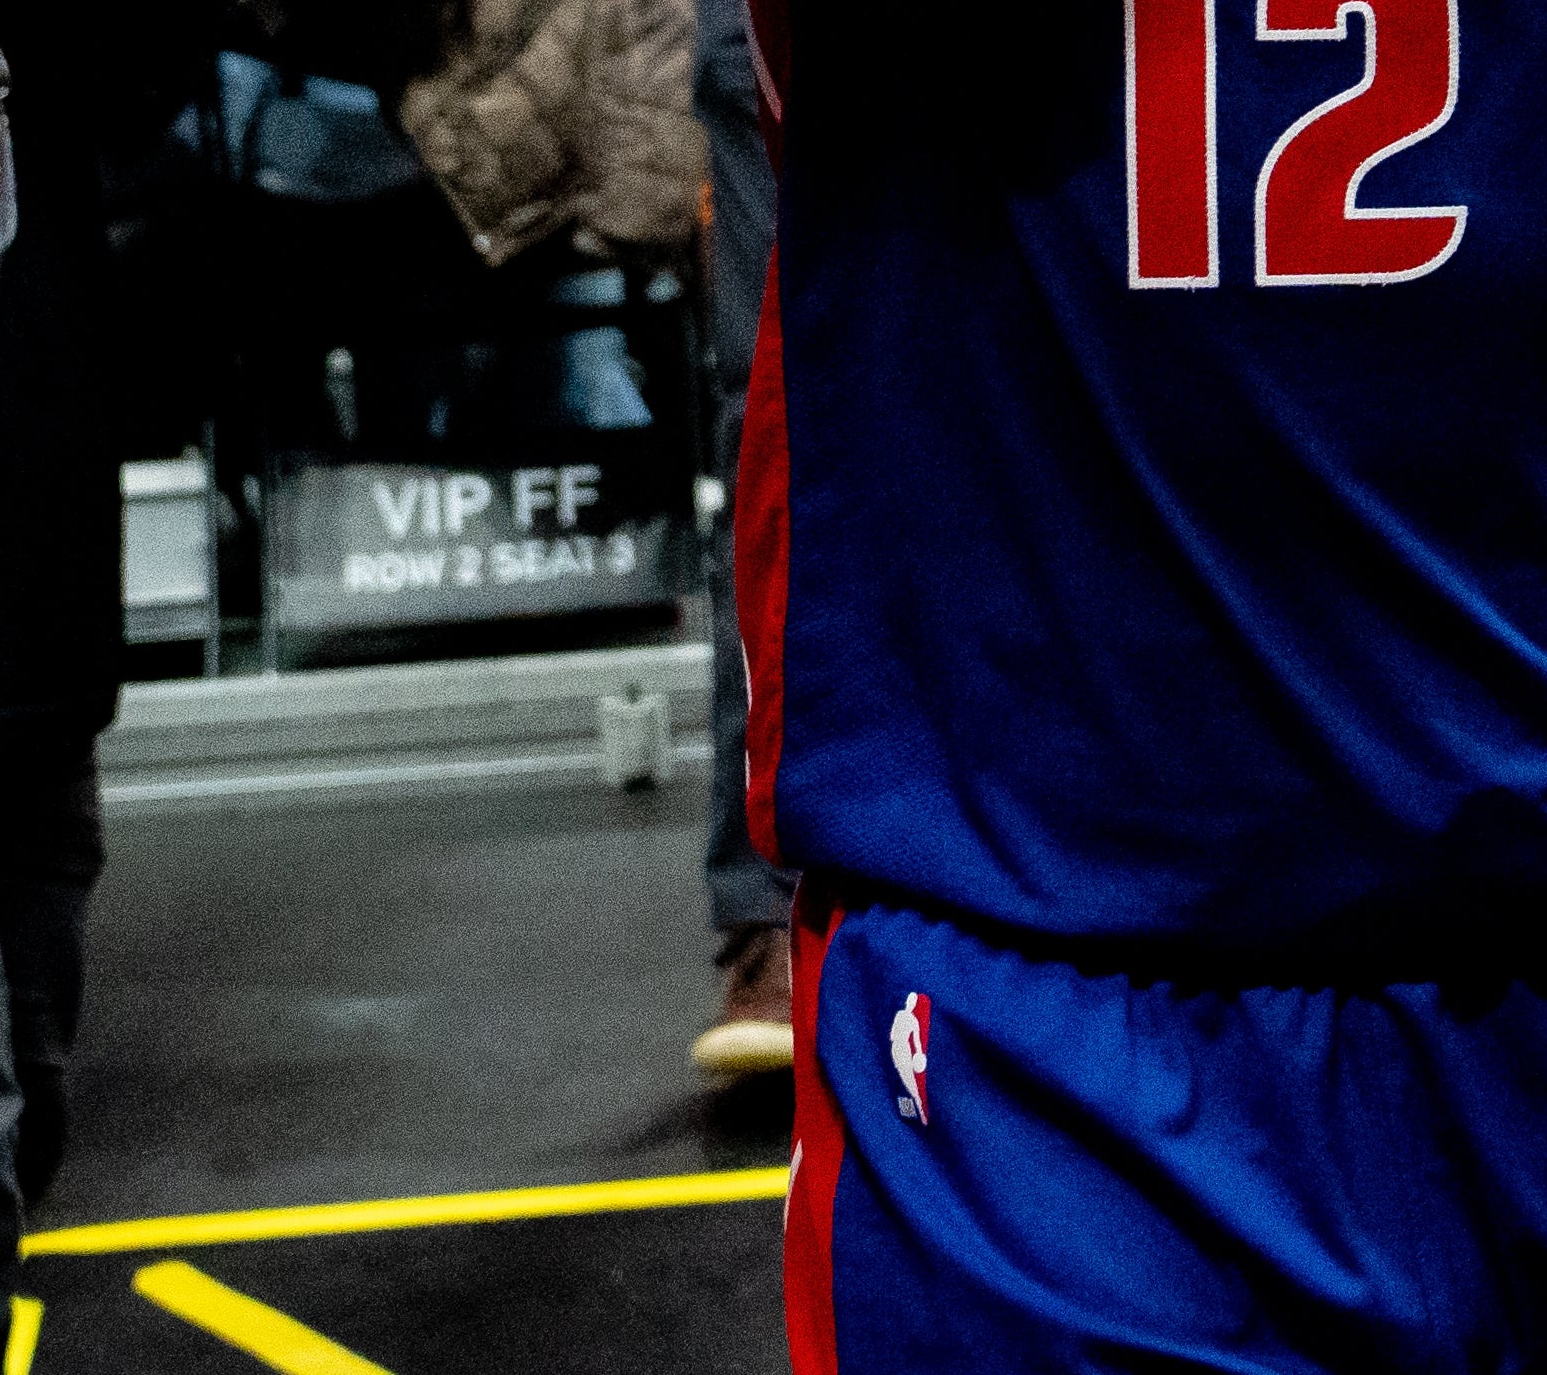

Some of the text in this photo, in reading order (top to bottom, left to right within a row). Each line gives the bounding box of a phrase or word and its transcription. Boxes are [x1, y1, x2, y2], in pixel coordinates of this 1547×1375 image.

[372, 463, 603, 539] VIP FF
[344, 551, 446, 594] ROW
[492, 536, 599, 584] SEAT
